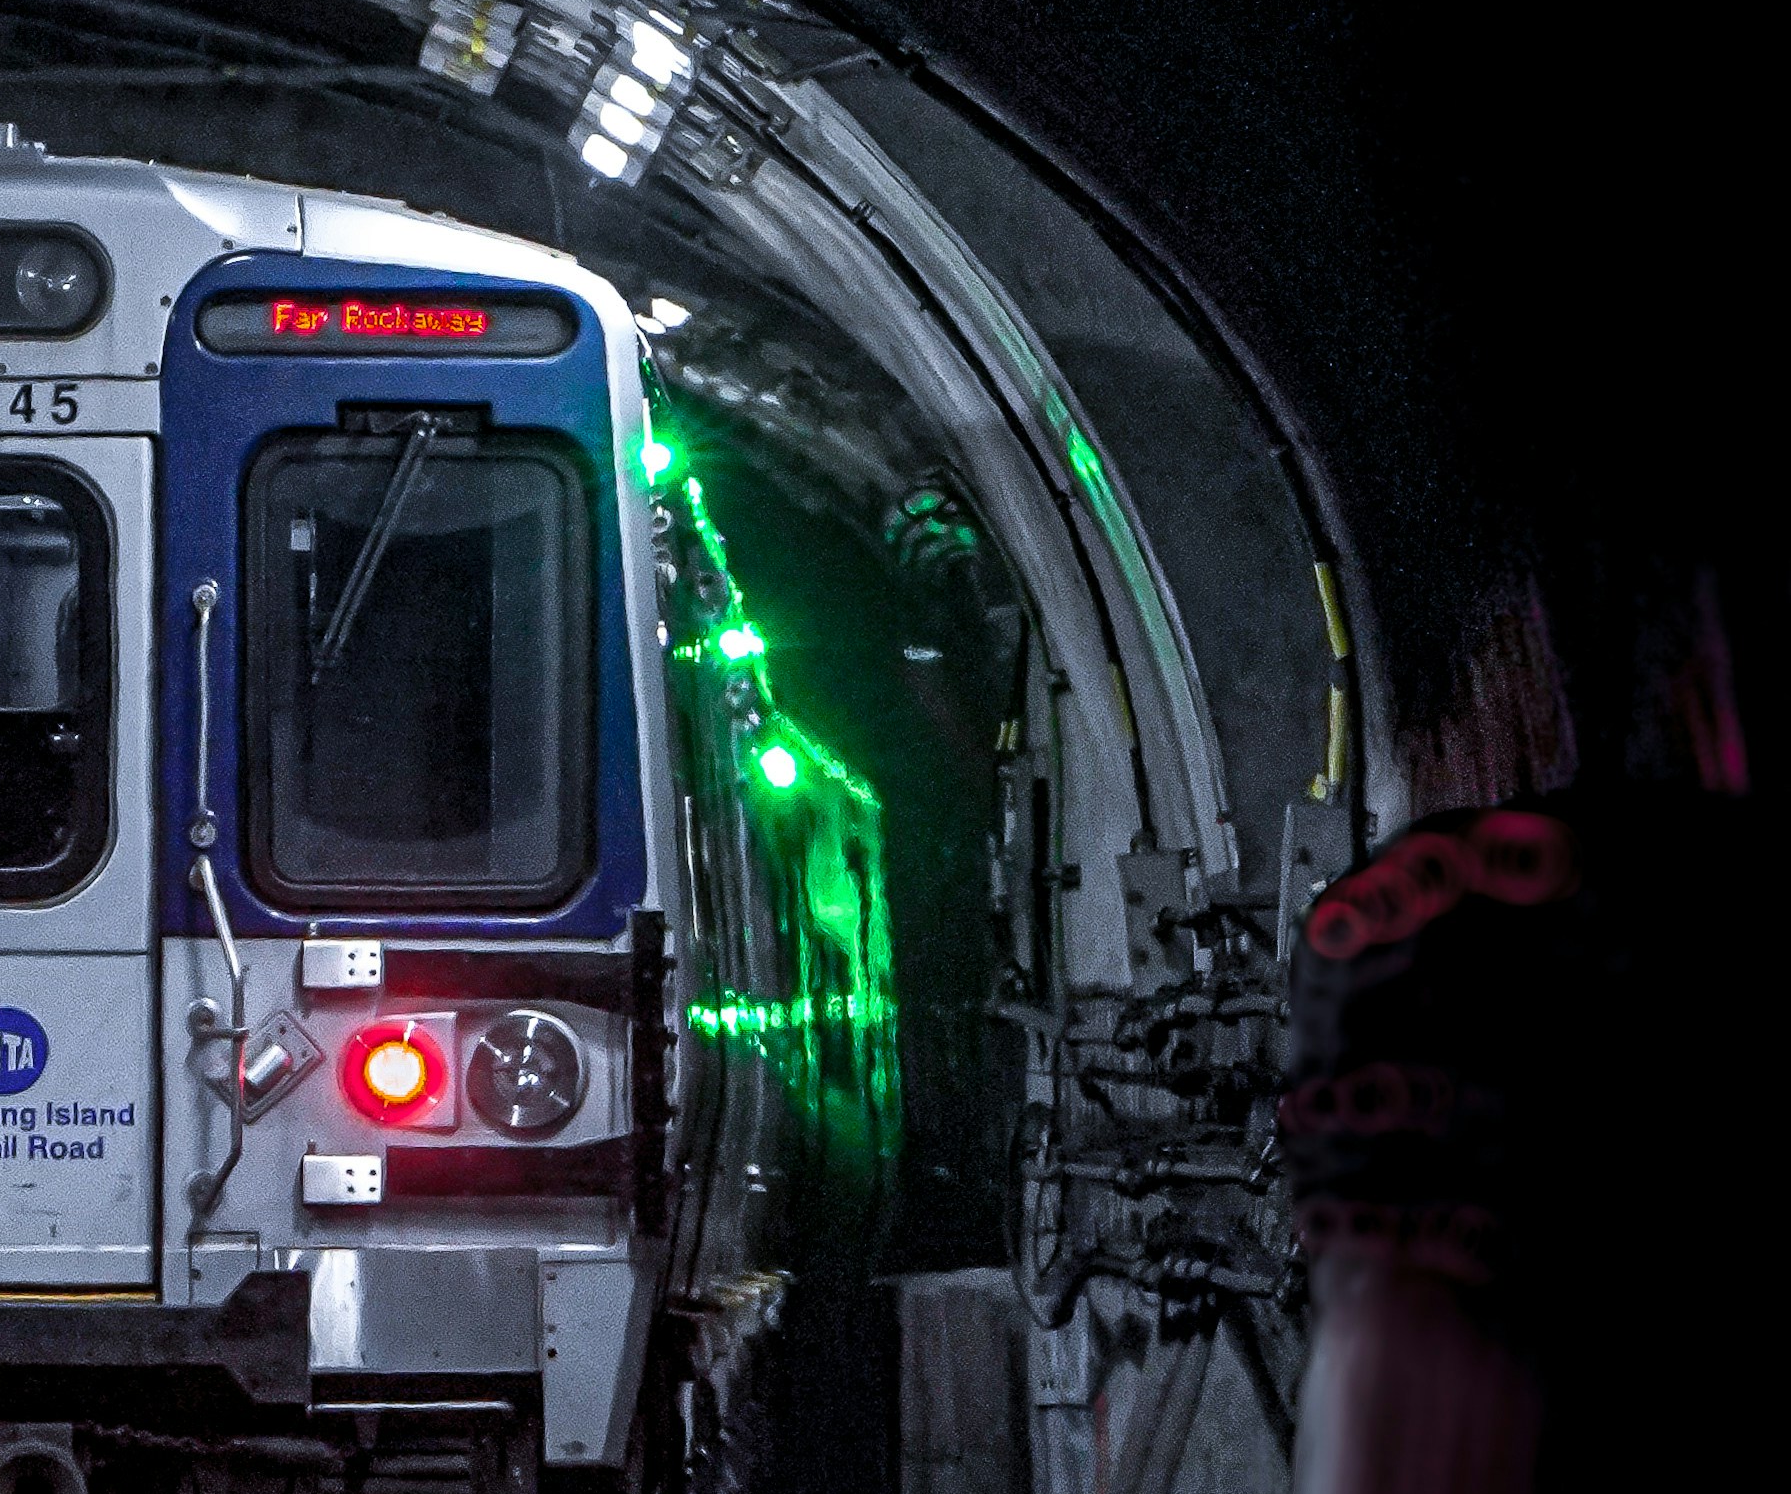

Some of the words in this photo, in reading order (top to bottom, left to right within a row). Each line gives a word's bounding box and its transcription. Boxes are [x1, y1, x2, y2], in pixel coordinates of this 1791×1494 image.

[273, 301, 329, 335] Far
[45, 1101, 135, 1127] Island
[28, 1135, 104, 1160] Road
